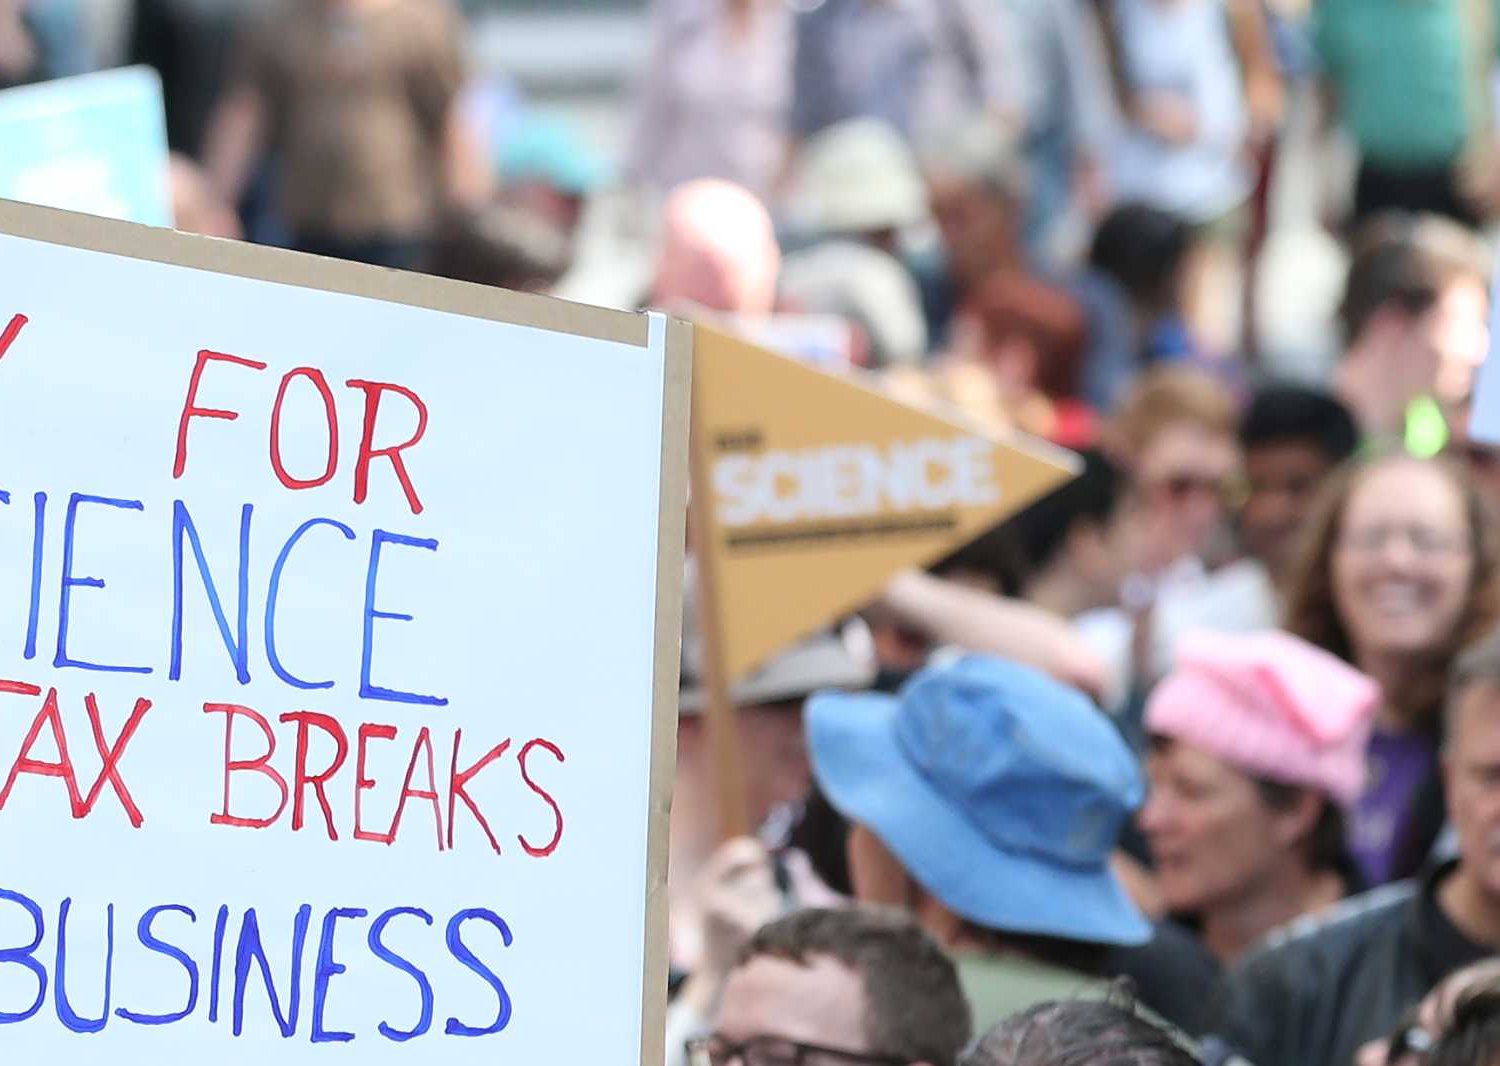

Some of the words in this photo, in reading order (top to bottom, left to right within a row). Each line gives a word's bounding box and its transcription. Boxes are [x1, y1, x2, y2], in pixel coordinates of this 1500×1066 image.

[173, 349, 428, 514] FOR
[710, 438, 1000, 527] SCIENCE
[203, 703, 565, 857] BREAKS
